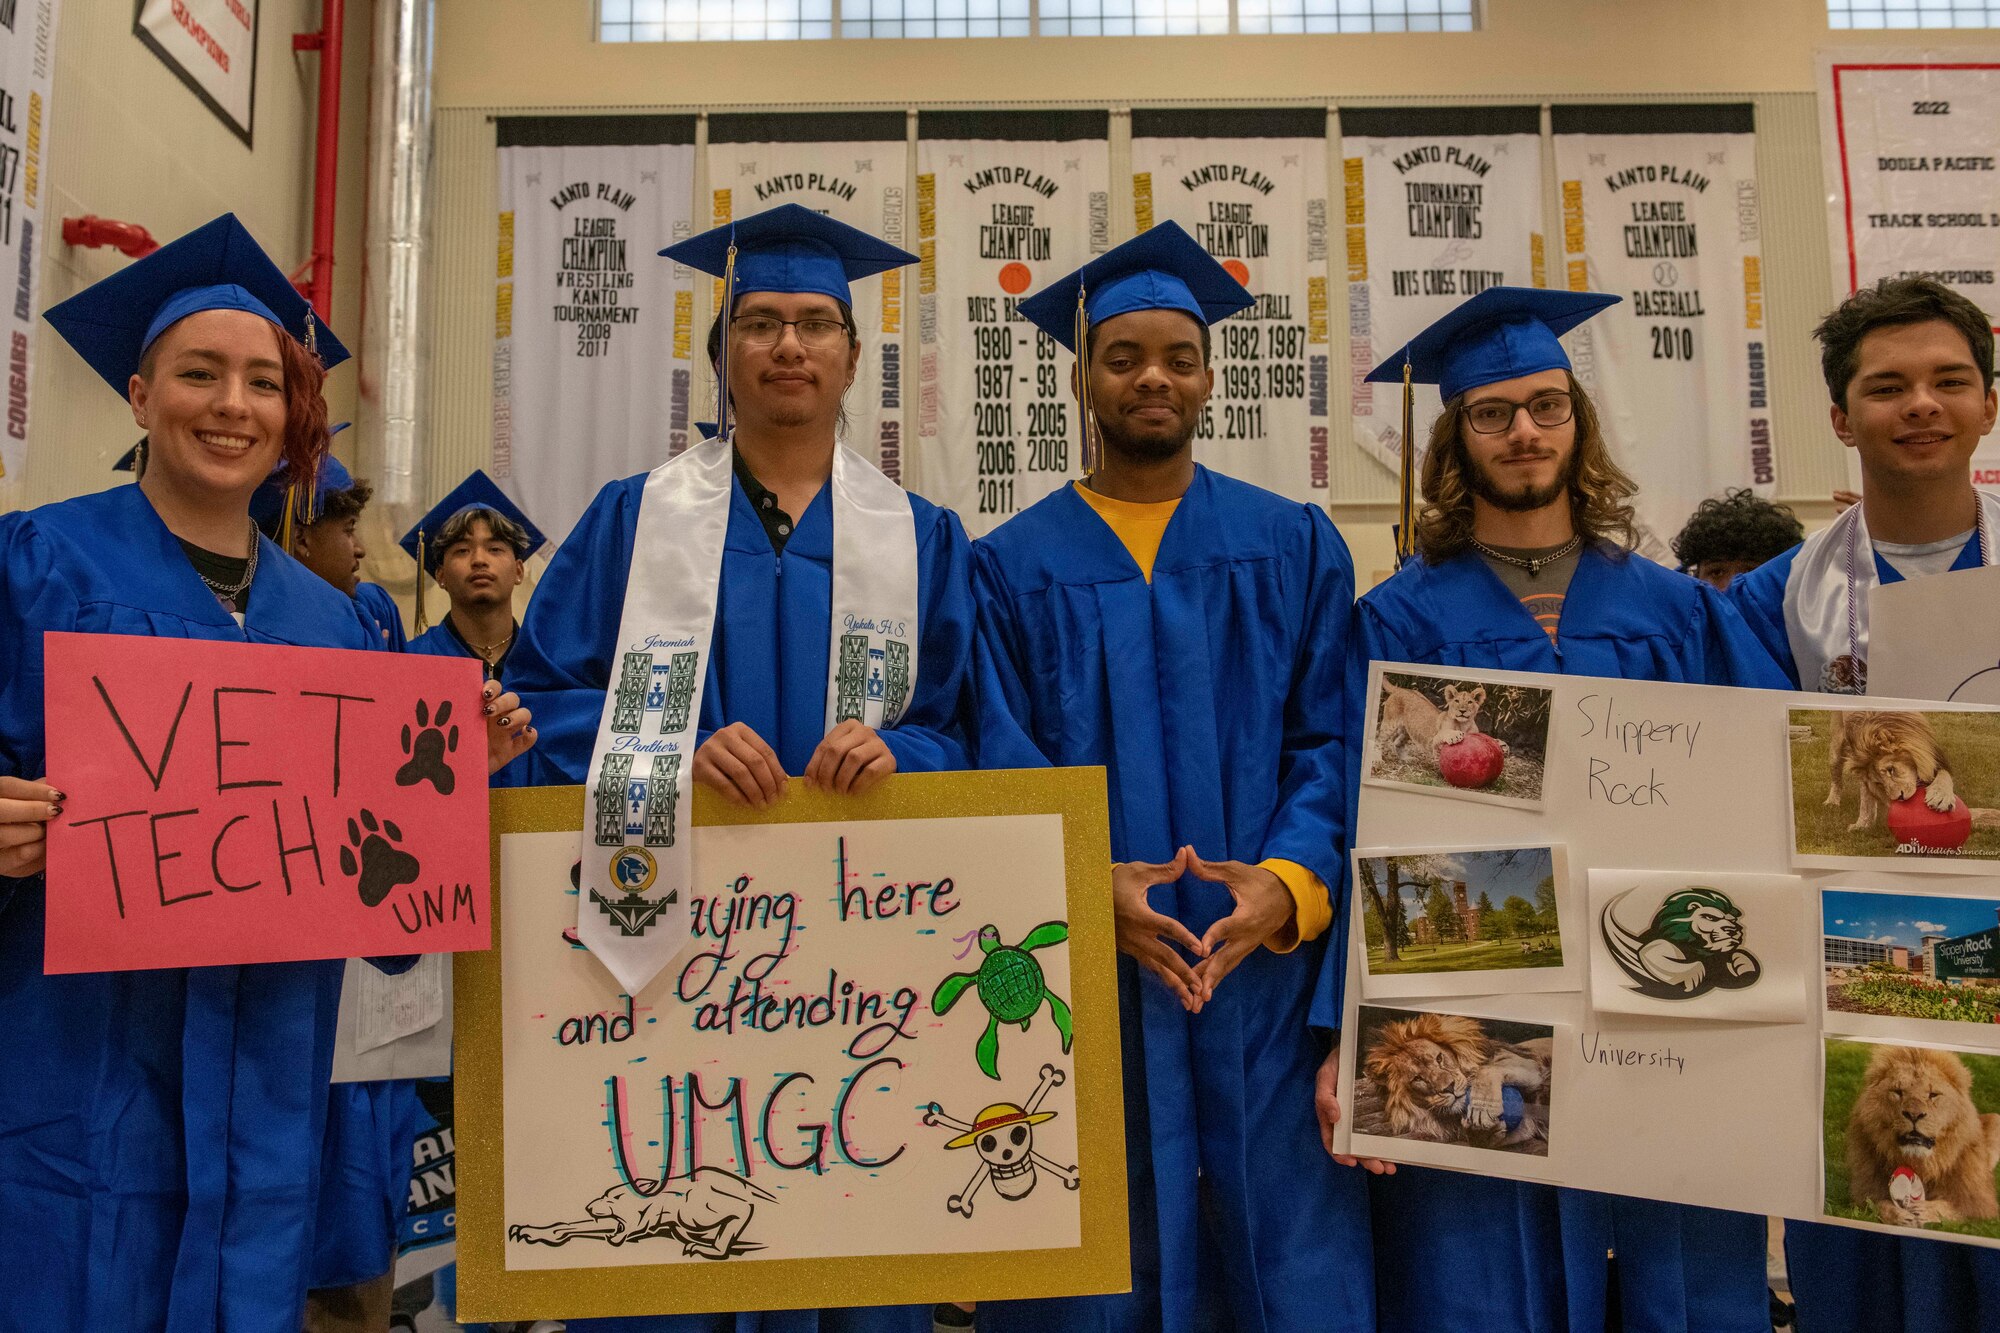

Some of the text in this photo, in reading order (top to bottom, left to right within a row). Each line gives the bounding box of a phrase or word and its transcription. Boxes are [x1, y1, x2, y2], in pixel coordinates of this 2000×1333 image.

[1913, 101, 1950, 115] 2022
[1393, 145, 1492, 178] KANTO PLAIN
[1878, 157, 1995, 171] DODEA PACIFIC
[754, 173, 857, 202] KANTO PLAIN
[964, 166, 1059, 199] KANTO PLAIN
[1181, 164, 1275, 196] KANTO PLAIN
[1405, 182, 1483, 205] TOURNAMENT
[1605, 165, 1711, 194] KANTO PLAIN
[550, 182, 636, 212] KANTO PLAIN
[1209, 201, 1253, 224] LEAGUE
[1631, 201, 1686, 222] LEAGUE
[574, 217, 616, 238] LEAGUE
[992, 204, 1034, 226] LEAGUE
[1408, 204, 1482, 239] CHAMPIONS
[1868, 214, 1923, 228] TRACK
[1927, 213, 1987, 228] SCHOOL
[562, 238, 627, 272] CHAMPION
[980, 225, 1051, 261] CHAMPION
[1624, 223, 1699, 258] CHAMPION
[556, 272, 634, 289] WRESTLING
[1423, 269, 1456, 295] CROSS
[1743, 256, 1762, 329] PANTHERS
[572, 289, 618, 306] KANTO
[967, 296, 996, 323] BOYS
[1308, 276, 1328, 344] PANTHERS
[1633, 290, 1705, 318] BASEBALL
[553, 305, 639, 324] TOURNAMENT
[673, 290, 693, 360] PANTHERS
[578, 323, 611, 340] 2008
[974, 326, 1012, 360] 1980
[1268, 325, 1306, 360] 1987
[1651, 326, 1693, 361] 2010
[577, 340, 608, 357] 2011
[7, 330, 28, 440] COUGARS
[881, 343, 900, 409] DRAGONS
[974, 364, 1013, 399] 1987
[1037, 364, 1057, 398] 93
[1266, 364, 1304, 399] 1995
[1748, 342, 1767, 409] DRAGONS
[1027, 403, 1067, 438] 2005
[1027, 439, 1068, 472] 2009
[1310, 426, 1329, 489] COUGARS
[1751, 417, 1774, 485] COUGARS
[844, 614, 875, 634] Yokota
[631, 634, 695, 652] Jeremiah
[92, 675, 376, 797] VET
[1577, 694, 1701, 759] Slippery
[612, 735, 679, 752] Panthers
[1589, 757, 1669, 806] Rock
[69, 795, 325, 919] TECH
[1917, 844, 1956, 854] Wildlife
[838, 836, 962, 923] here
[392, 883, 476, 934] UNM
[1953, 953, 1984, 967] University
[558, 969, 919, 1060] and attending
[1581, 1031, 1684, 1075] University
[604, 1058, 908, 1198] UMGC
